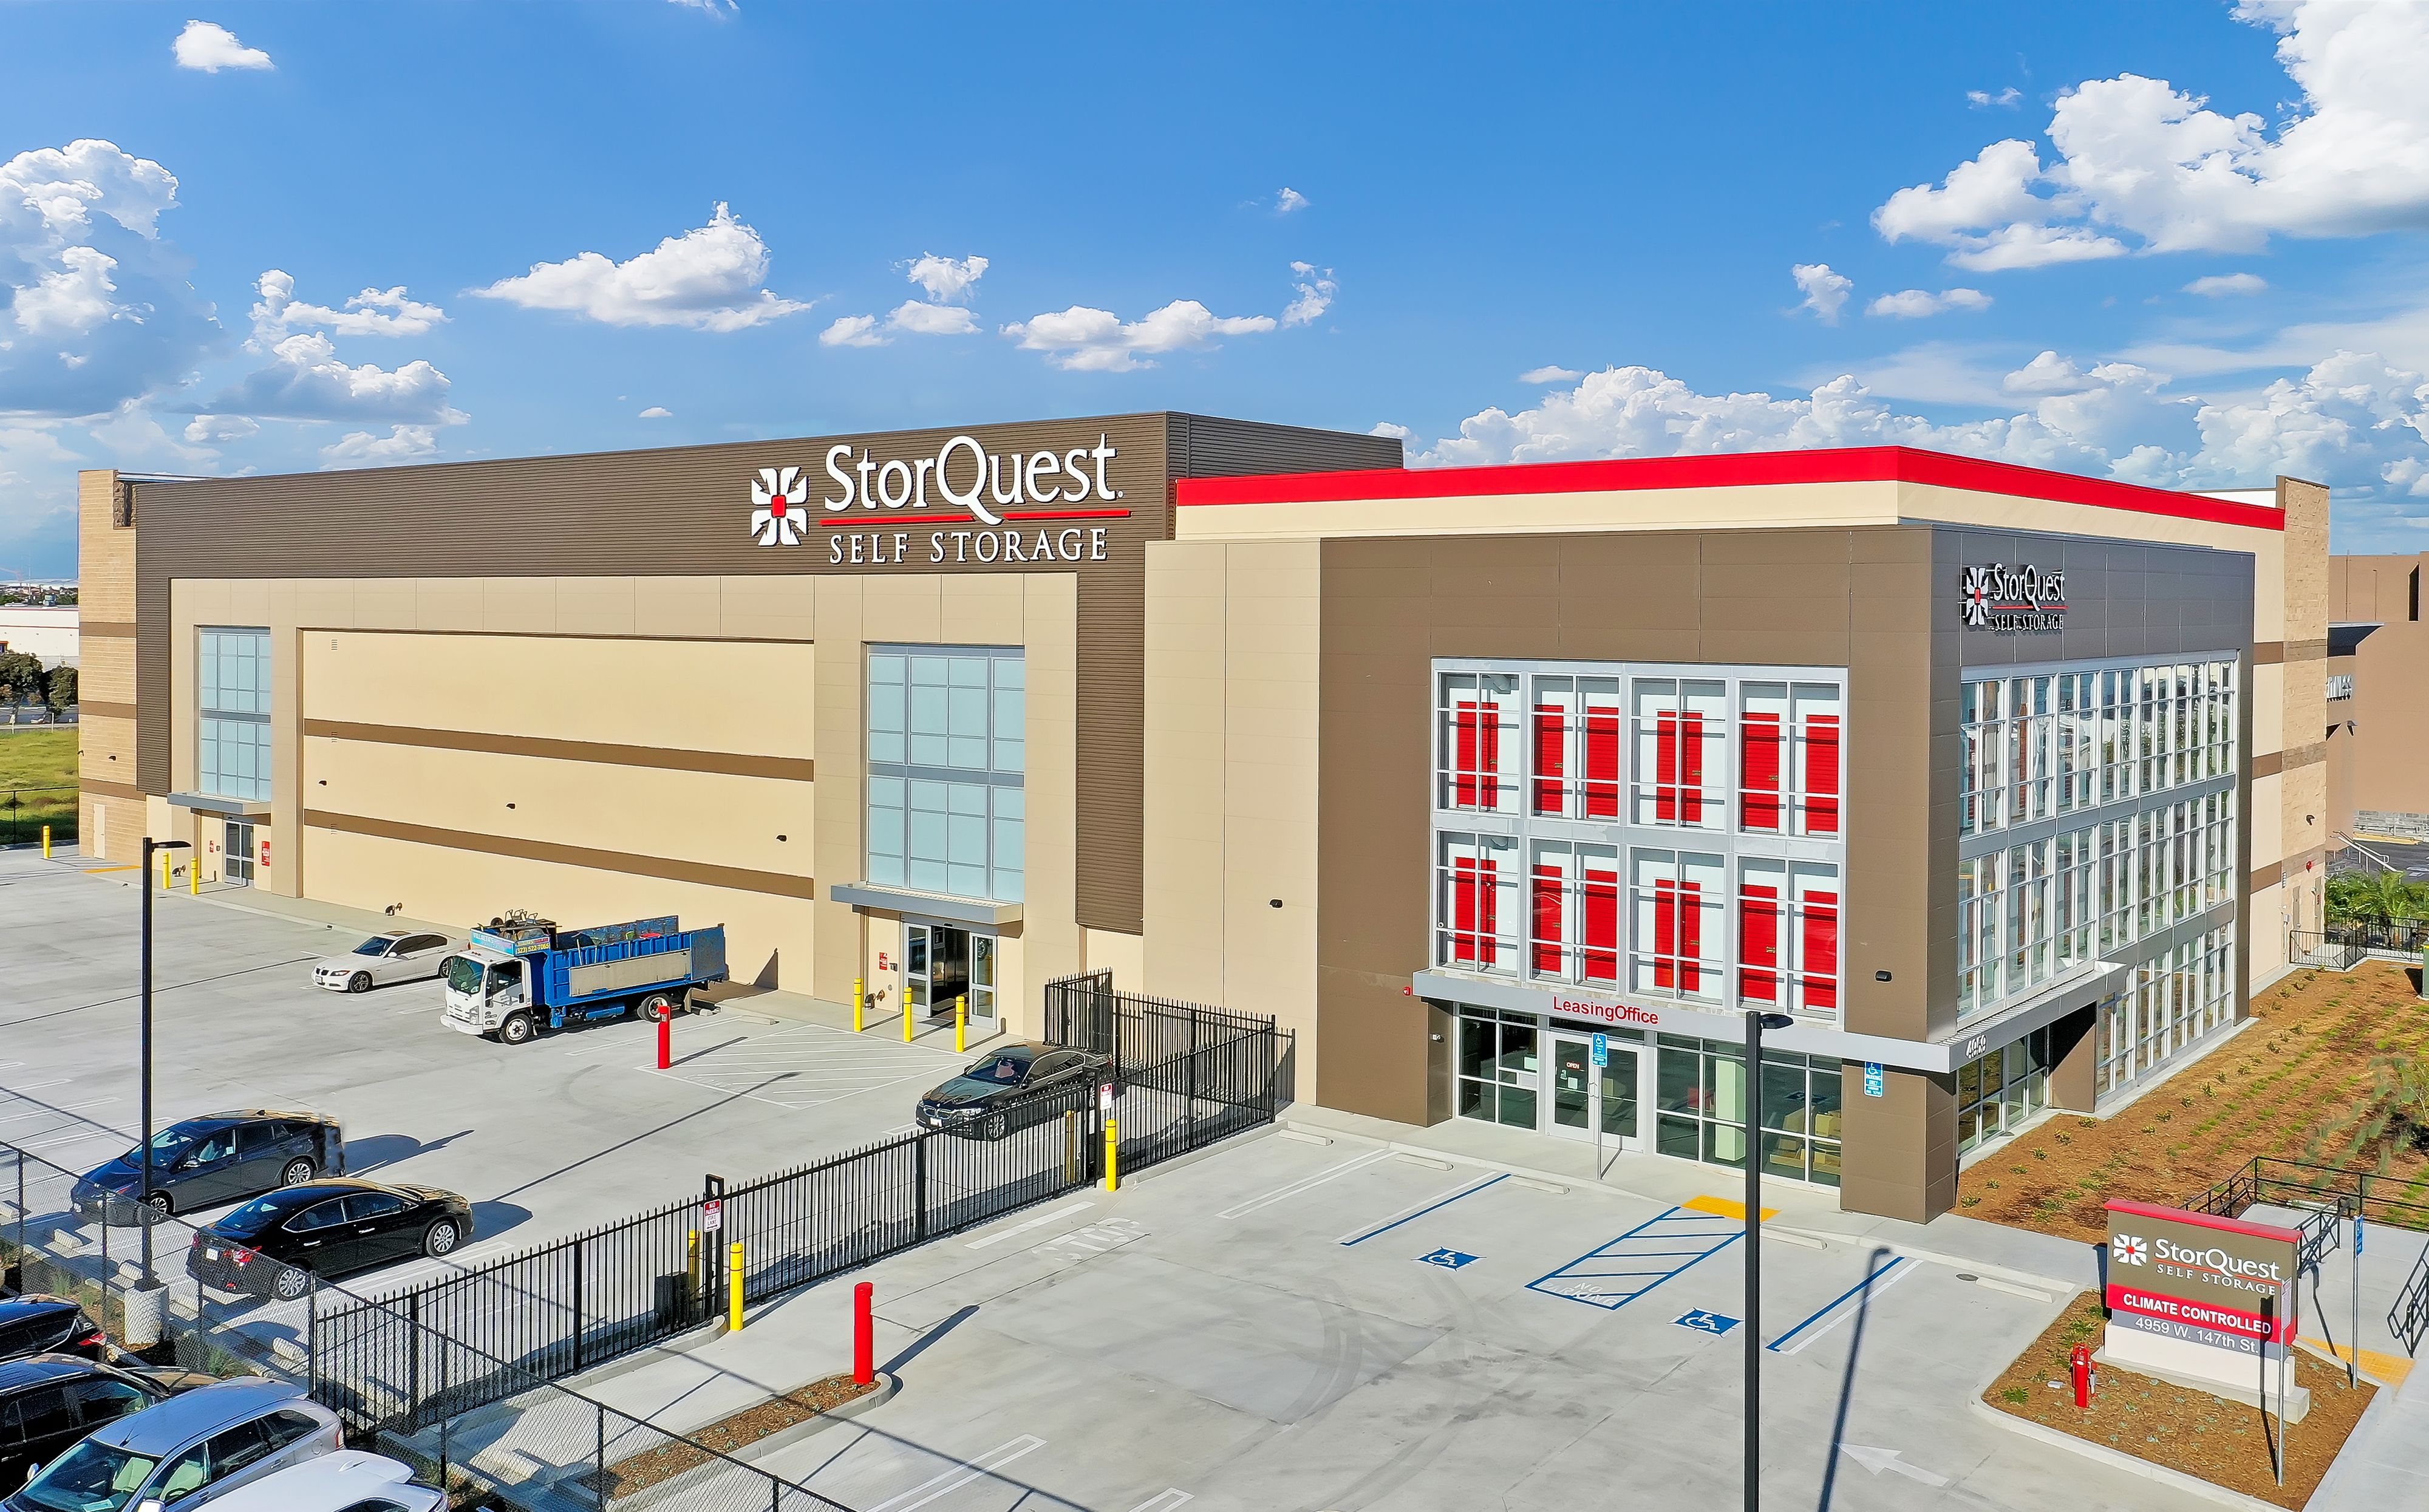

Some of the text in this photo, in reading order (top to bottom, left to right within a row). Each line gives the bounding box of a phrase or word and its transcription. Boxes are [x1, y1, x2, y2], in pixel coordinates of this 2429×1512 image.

[823, 432, 1118, 525] StorQuest
[829, 528, 1108, 564] SELF STORAGE
[1994, 562, 2065, 611] StorQuest
[1995, 613, 2064, 632] SELF STORAGE
[1553, 995, 1660, 1025] LeasingOffice
[2154, 1238, 2280, 1281] StorQuest
[1538, 1281, 1618, 1306] PARKING
[1574, 1282, 1603, 1293] NO
[2156, 1264, 2276, 1296] SELF STORAGE
[2123, 1293, 2178, 1316] CLIMATE
[2181, 1306, 2271, 1335] CONTROLLED
[2135, 1316, 2259, 1354] 4959 W. 147th St.
